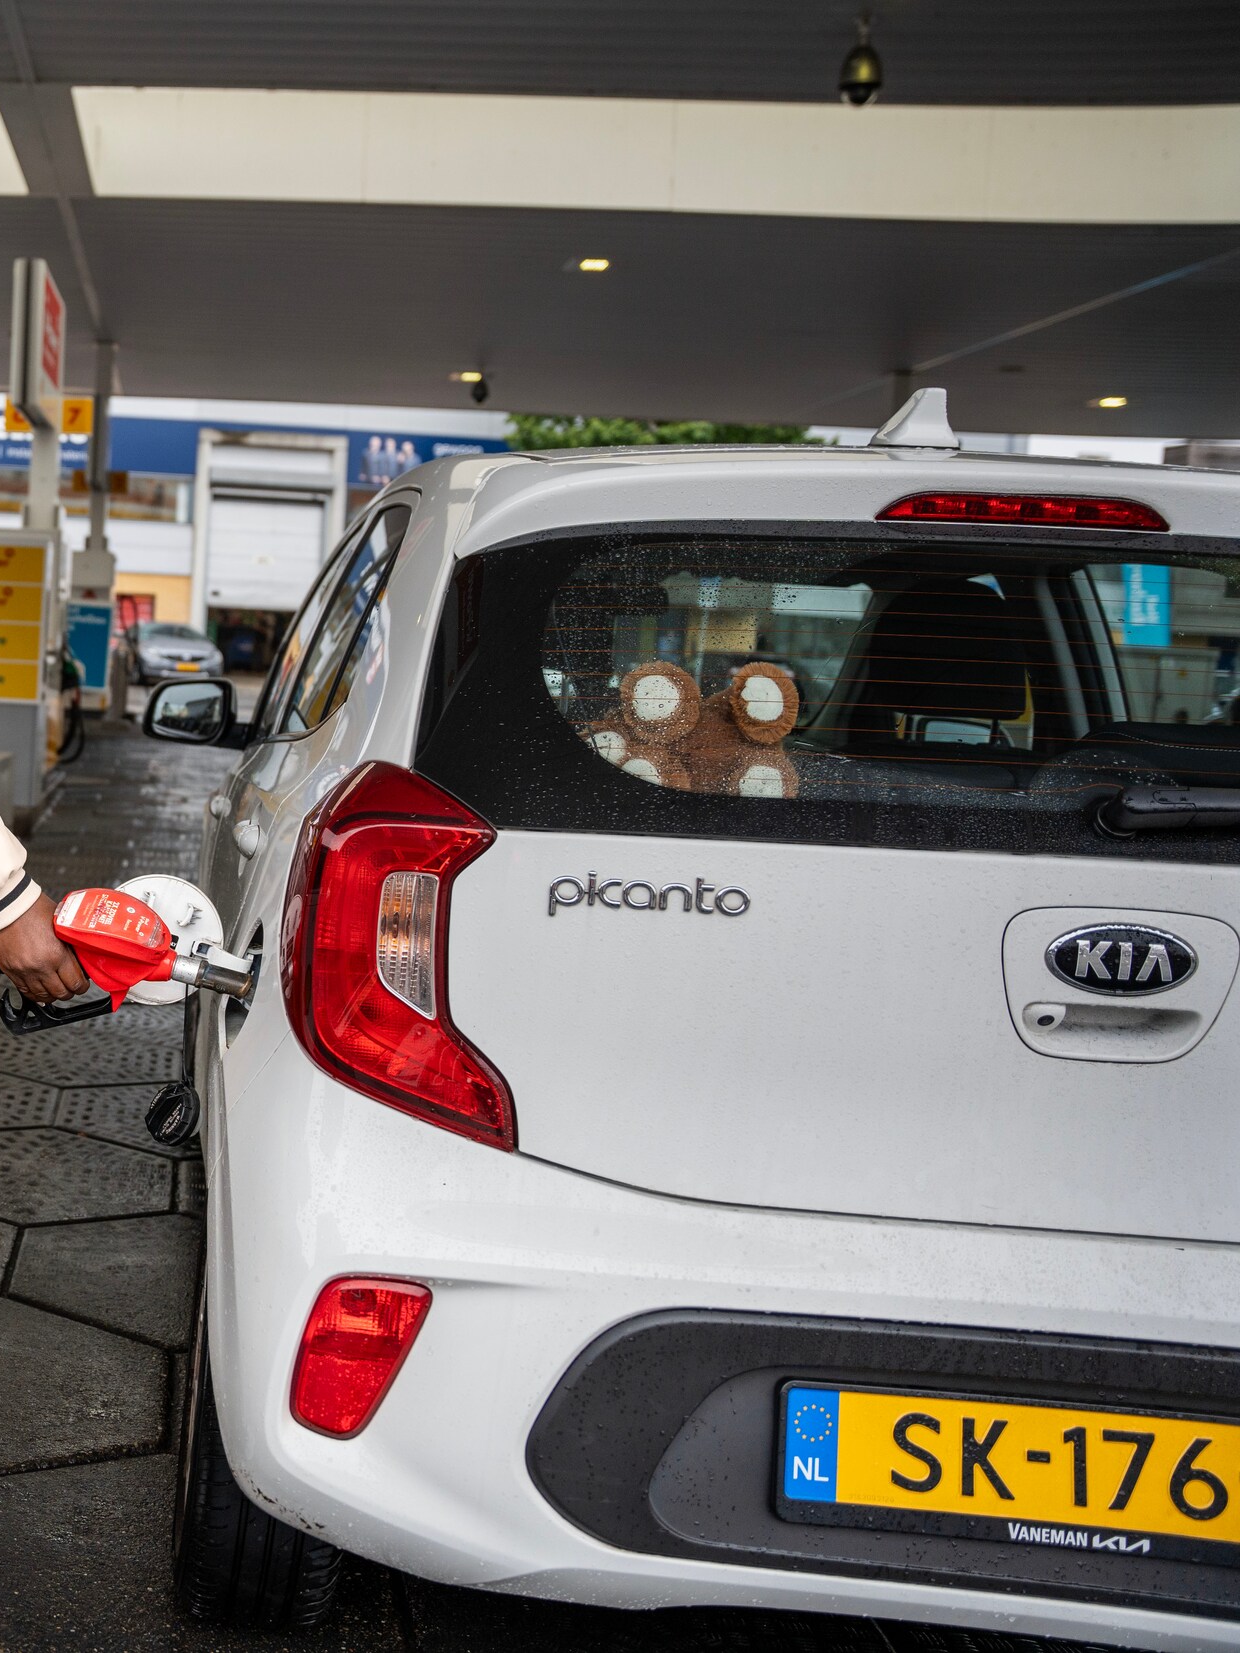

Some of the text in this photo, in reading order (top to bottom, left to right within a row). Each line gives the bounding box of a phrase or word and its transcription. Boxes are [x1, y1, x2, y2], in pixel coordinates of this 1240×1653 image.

[68, 407, 81, 425] 7
[548, 870, 752, 917] picanto
[1073, 938, 1174, 985] KIA
[793, 1455, 829, 1483] NL
[890, 1411, 1240, 1522] SK-176
[1008, 1522, 1088, 1549] VANEMAN
